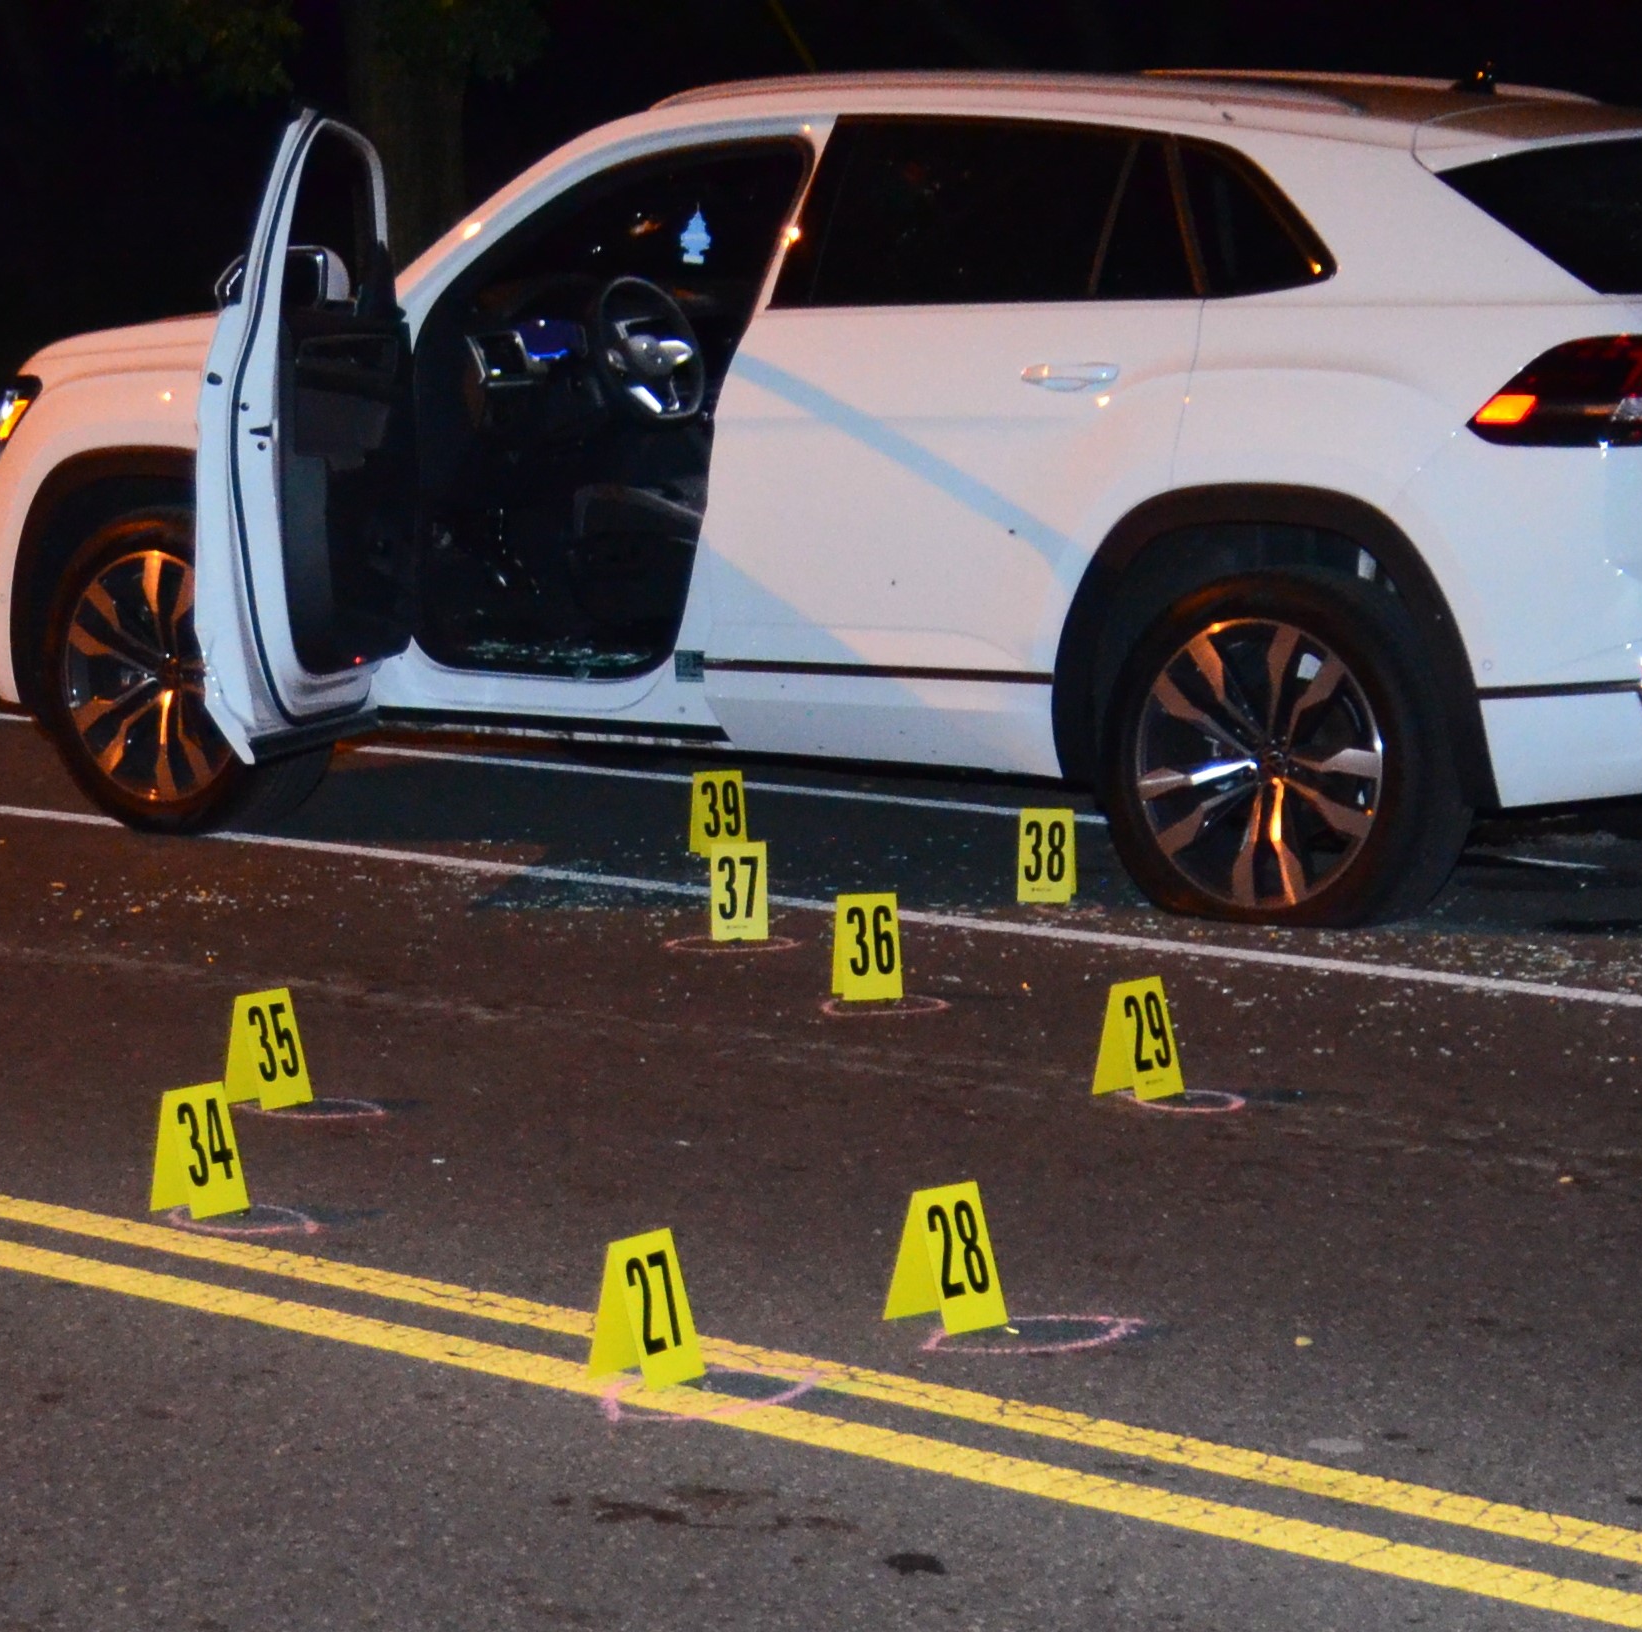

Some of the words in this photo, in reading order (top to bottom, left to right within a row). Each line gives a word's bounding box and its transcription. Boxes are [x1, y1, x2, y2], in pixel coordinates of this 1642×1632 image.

[701, 780, 741, 837] 39
[718, 856, 758, 919] 37
[1025, 821, 1065, 882] 38
[847, 905, 895, 976] 36
[248, 1003, 299, 1082] 35
[1124, 991, 1171, 1072] 29
[177, 1098, 234, 1186] 34
[928, 1200, 989, 1299] 28
[626, 1250, 682, 1355] 27
